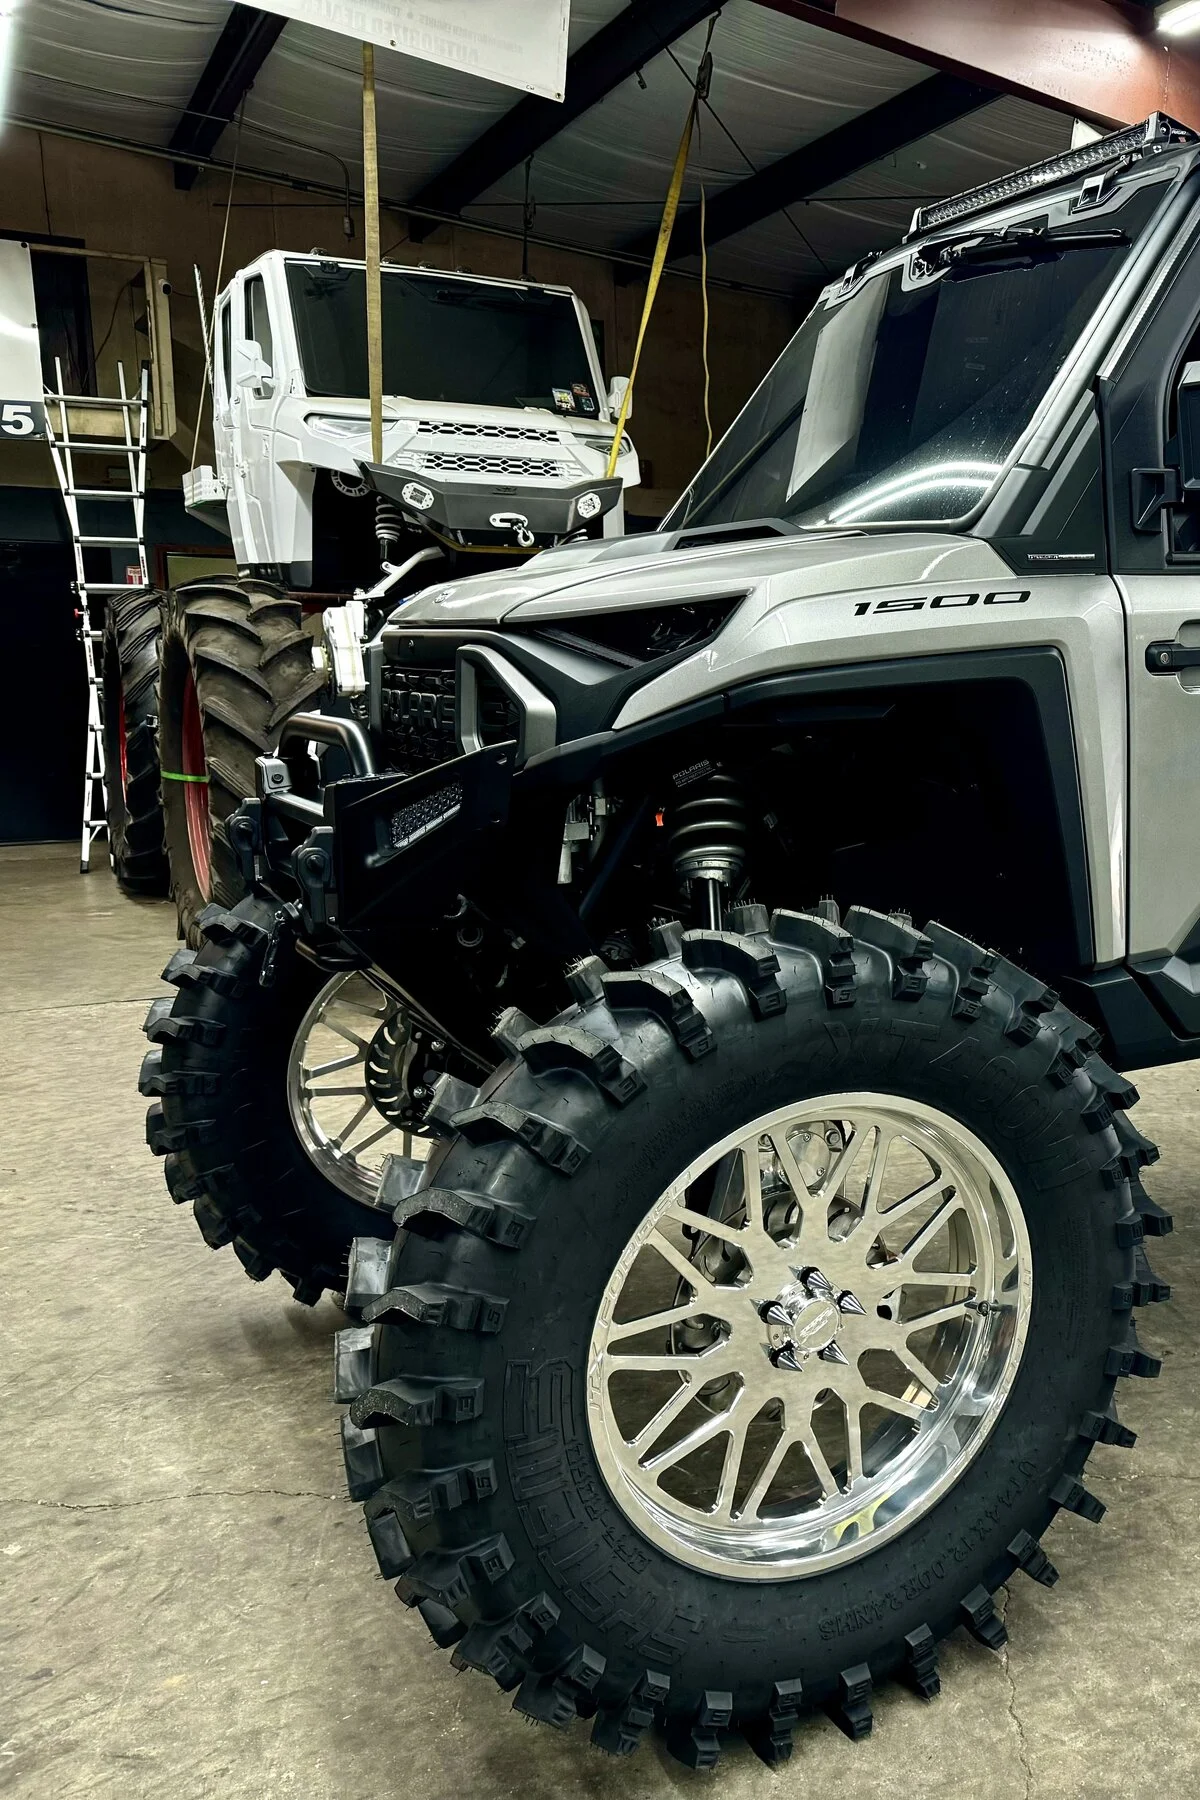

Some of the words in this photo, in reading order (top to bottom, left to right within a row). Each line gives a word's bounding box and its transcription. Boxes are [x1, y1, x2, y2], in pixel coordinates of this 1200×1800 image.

[1, 404, 35, 436] 5
[854, 590, 1032, 616] 1500
[672, 759, 710, 780] POLARIS
